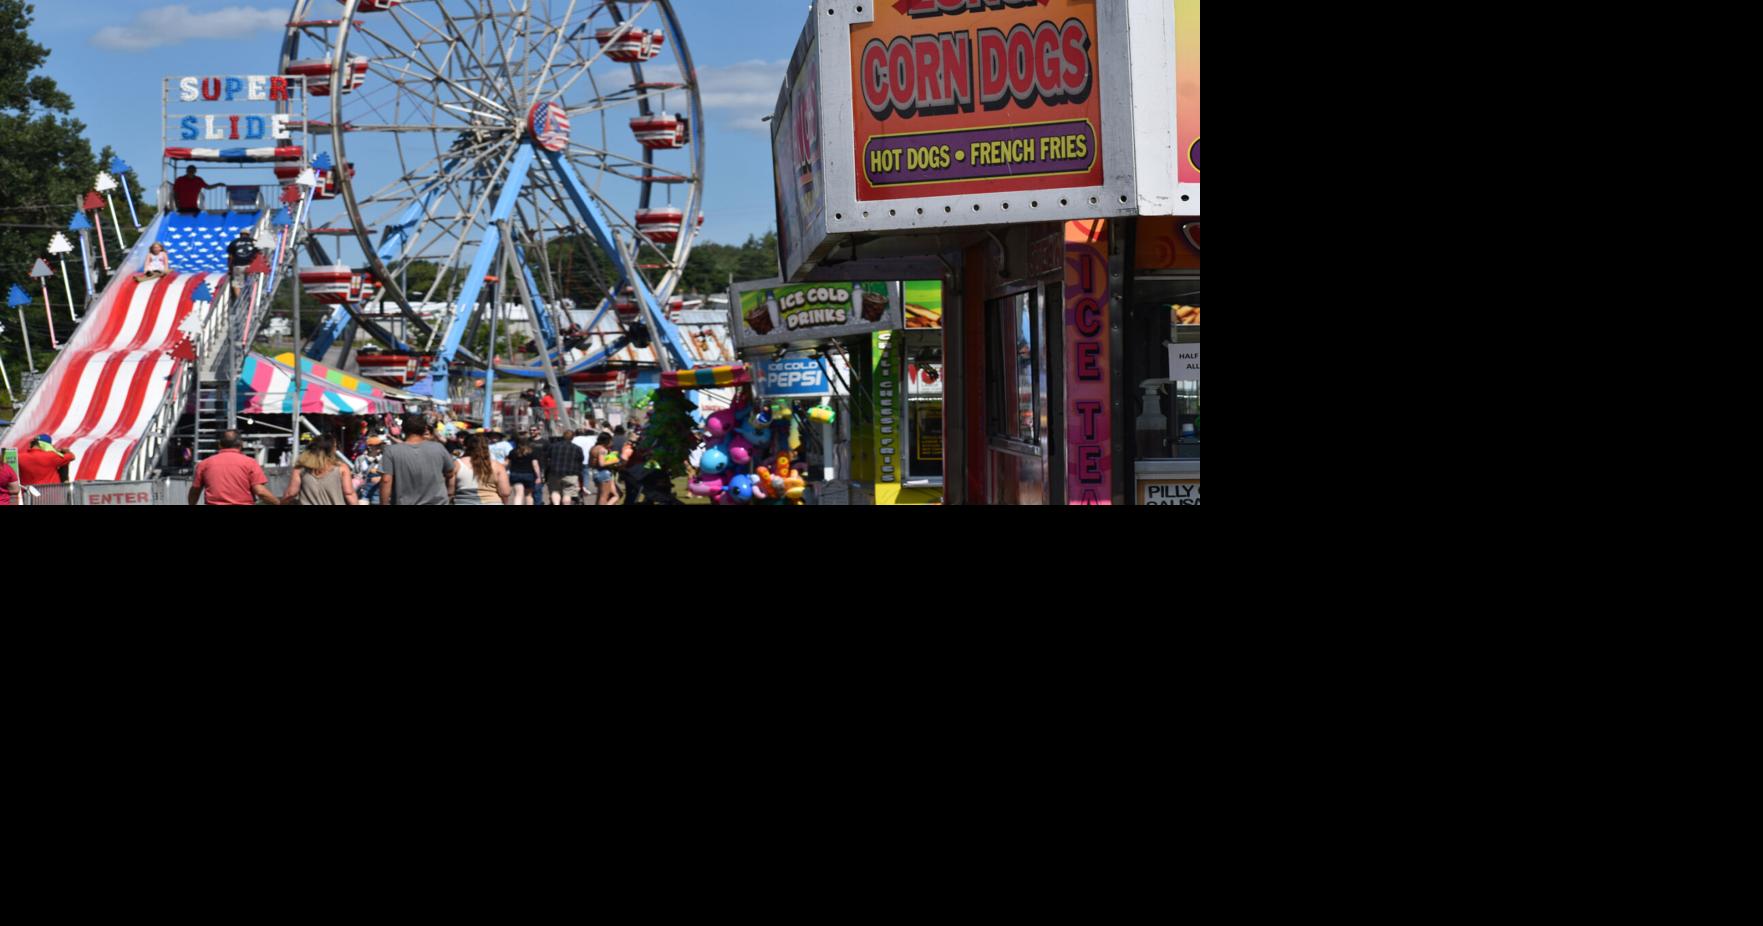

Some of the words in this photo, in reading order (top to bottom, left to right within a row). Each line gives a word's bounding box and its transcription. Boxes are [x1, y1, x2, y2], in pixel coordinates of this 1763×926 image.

[861, 30, 974, 119] CORN
[977, 18, 1092, 110] DOGS
[180, 76, 289, 101] SUPER
[180, 114, 290, 140] SLIDE
[870, 149, 903, 173] HOT
[907, 145, 950, 170] DOGS
[970, 139, 1035, 166] FRENCH
[1040, 134, 1087, 160] FRIES
[779, 291, 805, 311] ICE
[807, 287, 849, 304] COLD
[786, 308, 847, 331] DRINKS
[1075, 254, 1102, 380] ICE
[784, 361, 818, 370] COLD
[768, 370, 822, 388] PEPSI
[88, 492, 149, 505] ENTER
[1148, 484, 1194, 498] PILLY
